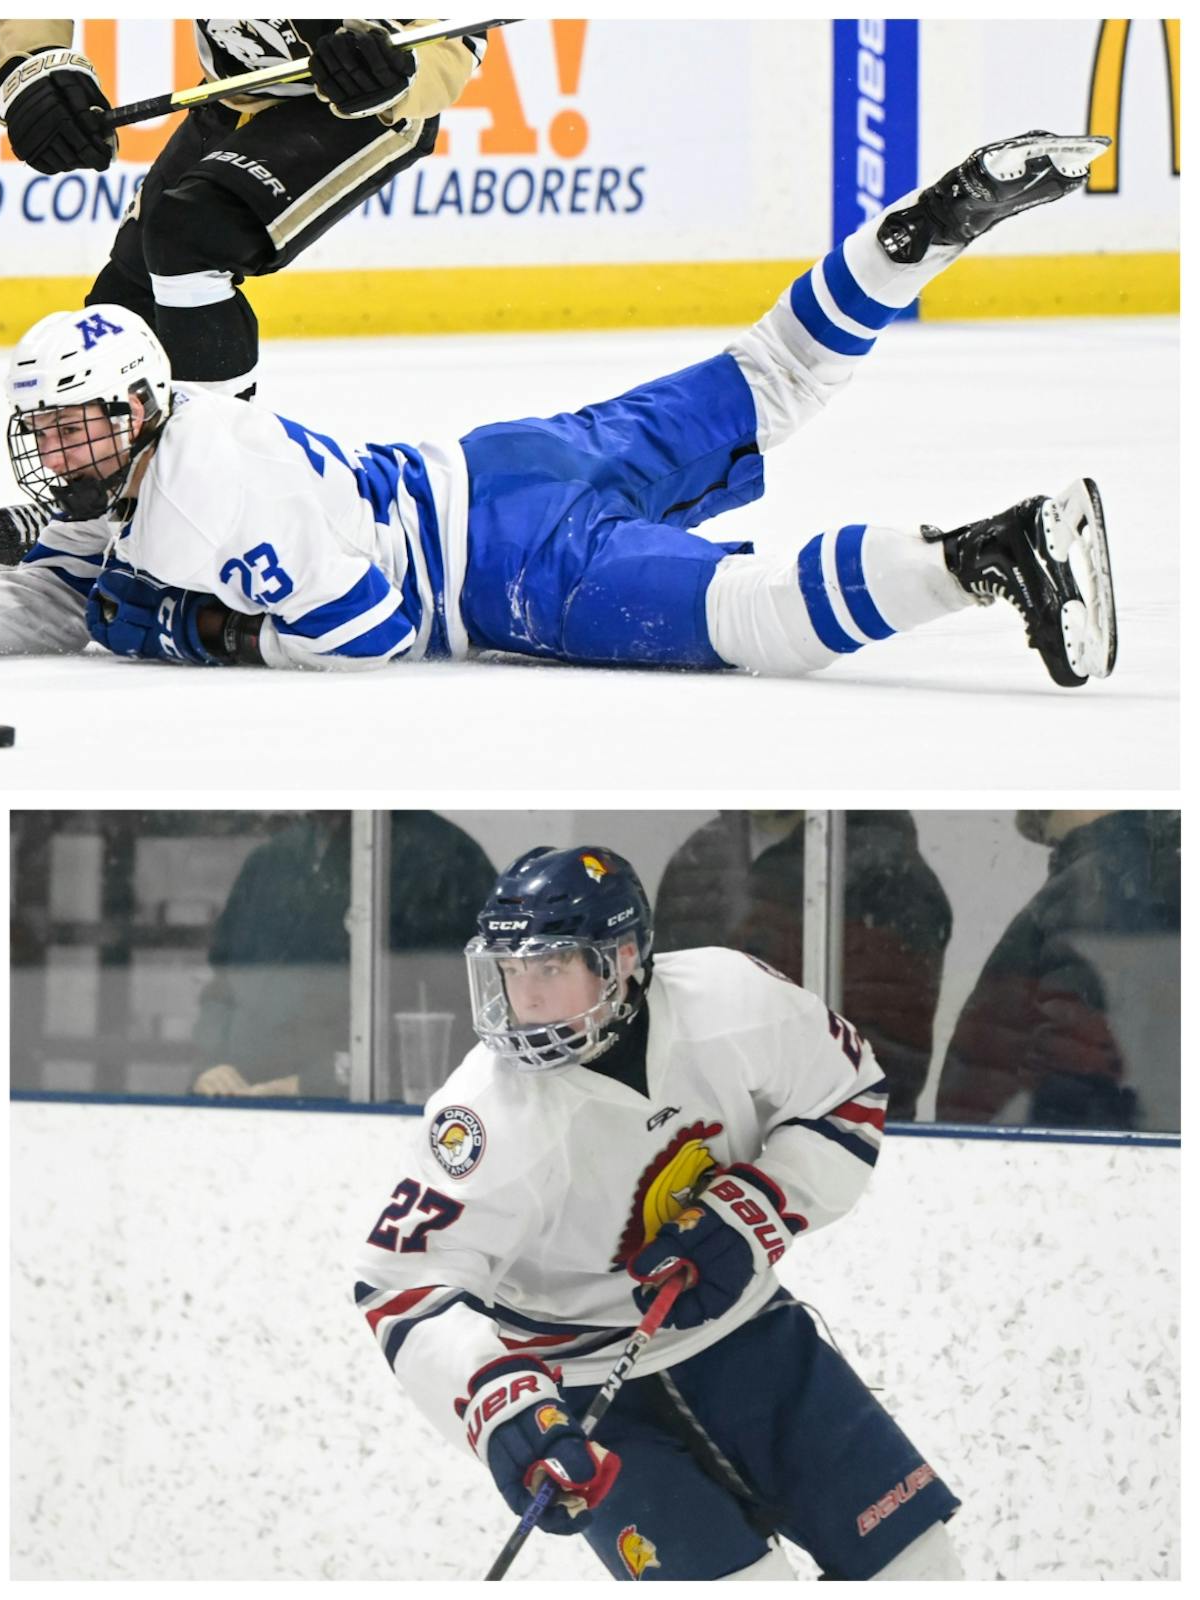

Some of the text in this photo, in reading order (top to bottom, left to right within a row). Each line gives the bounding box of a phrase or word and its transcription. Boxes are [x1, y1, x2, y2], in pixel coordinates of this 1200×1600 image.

[414, 165, 646, 219] LABORERS
[120, 355, 146, 376] CCM
[220, 542, 294, 606] 23
[488, 919, 529, 932] CCM
[606, 906, 636, 927] CCM
[444, 1109, 482, 1147] ORONO
[367, 1178, 466, 1254] 27
[599, 1342, 642, 1403] CCM
[856, 1463, 937, 1537] BAUER
